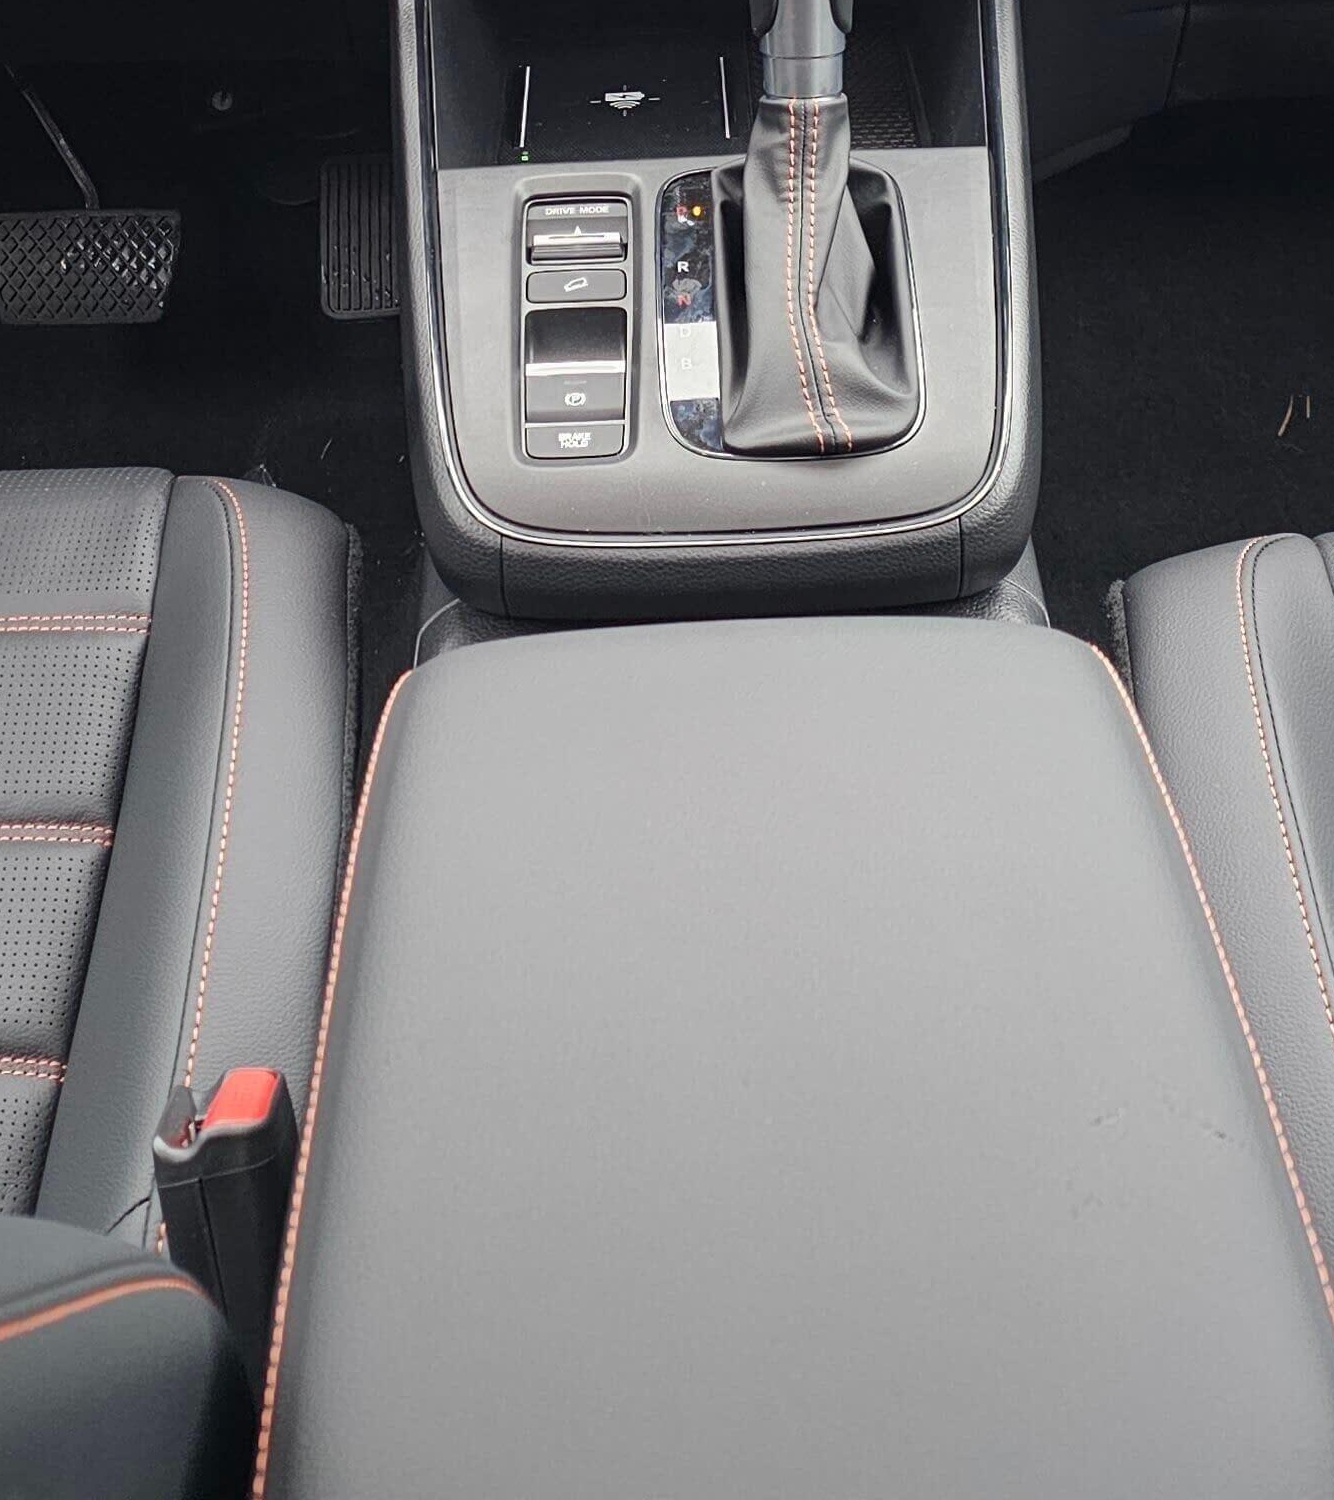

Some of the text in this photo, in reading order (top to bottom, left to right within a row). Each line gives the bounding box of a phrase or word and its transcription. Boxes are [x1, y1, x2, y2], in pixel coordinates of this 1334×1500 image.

[545, 205, 609, 215] DRIVE MODE
[677, 261, 689, 273] R
[677, 295, 692, 306] N
[680, 325, 692, 337] D
[681, 358, 693, 370] B
[558, 432, 591, 442] BRAKE
[560, 439, 590, 448] HOLD
